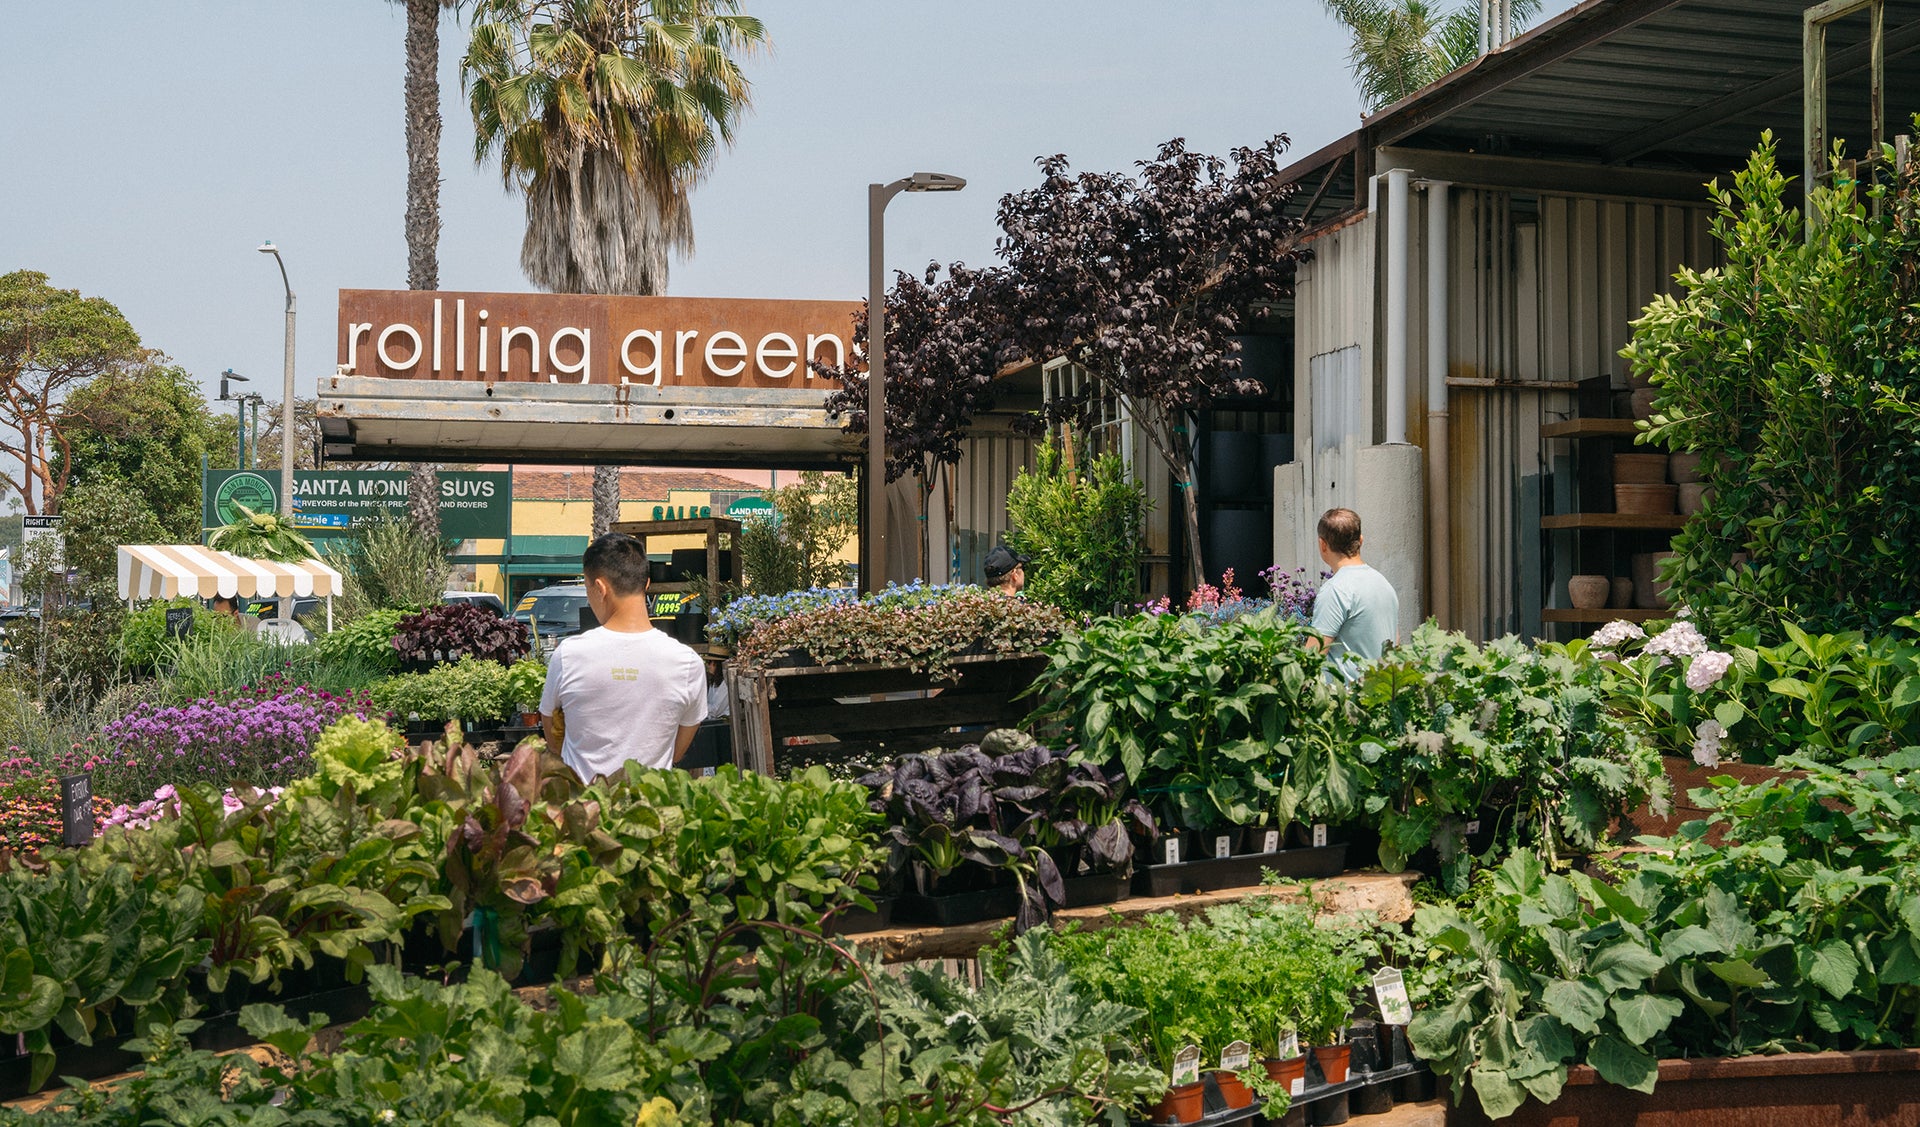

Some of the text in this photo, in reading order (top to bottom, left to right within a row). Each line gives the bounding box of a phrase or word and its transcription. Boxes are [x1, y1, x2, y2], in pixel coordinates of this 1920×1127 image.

[349, 298, 591, 385] rolling
[224, 477, 268, 496] SANTA MONICA
[358, 479, 408, 496] MONI
[441, 480, 495, 497] SUVS
[439, 501, 455, 509] AND
[456, 501, 488, 509] ROVERS
[729, 507, 773, 516] LAND ROVE
[652, 505, 711, 521] SALES
[25, 518, 45, 526] RIGHT
[297, 515, 328, 526] Maple
[655, 602, 681, 615] 16995
